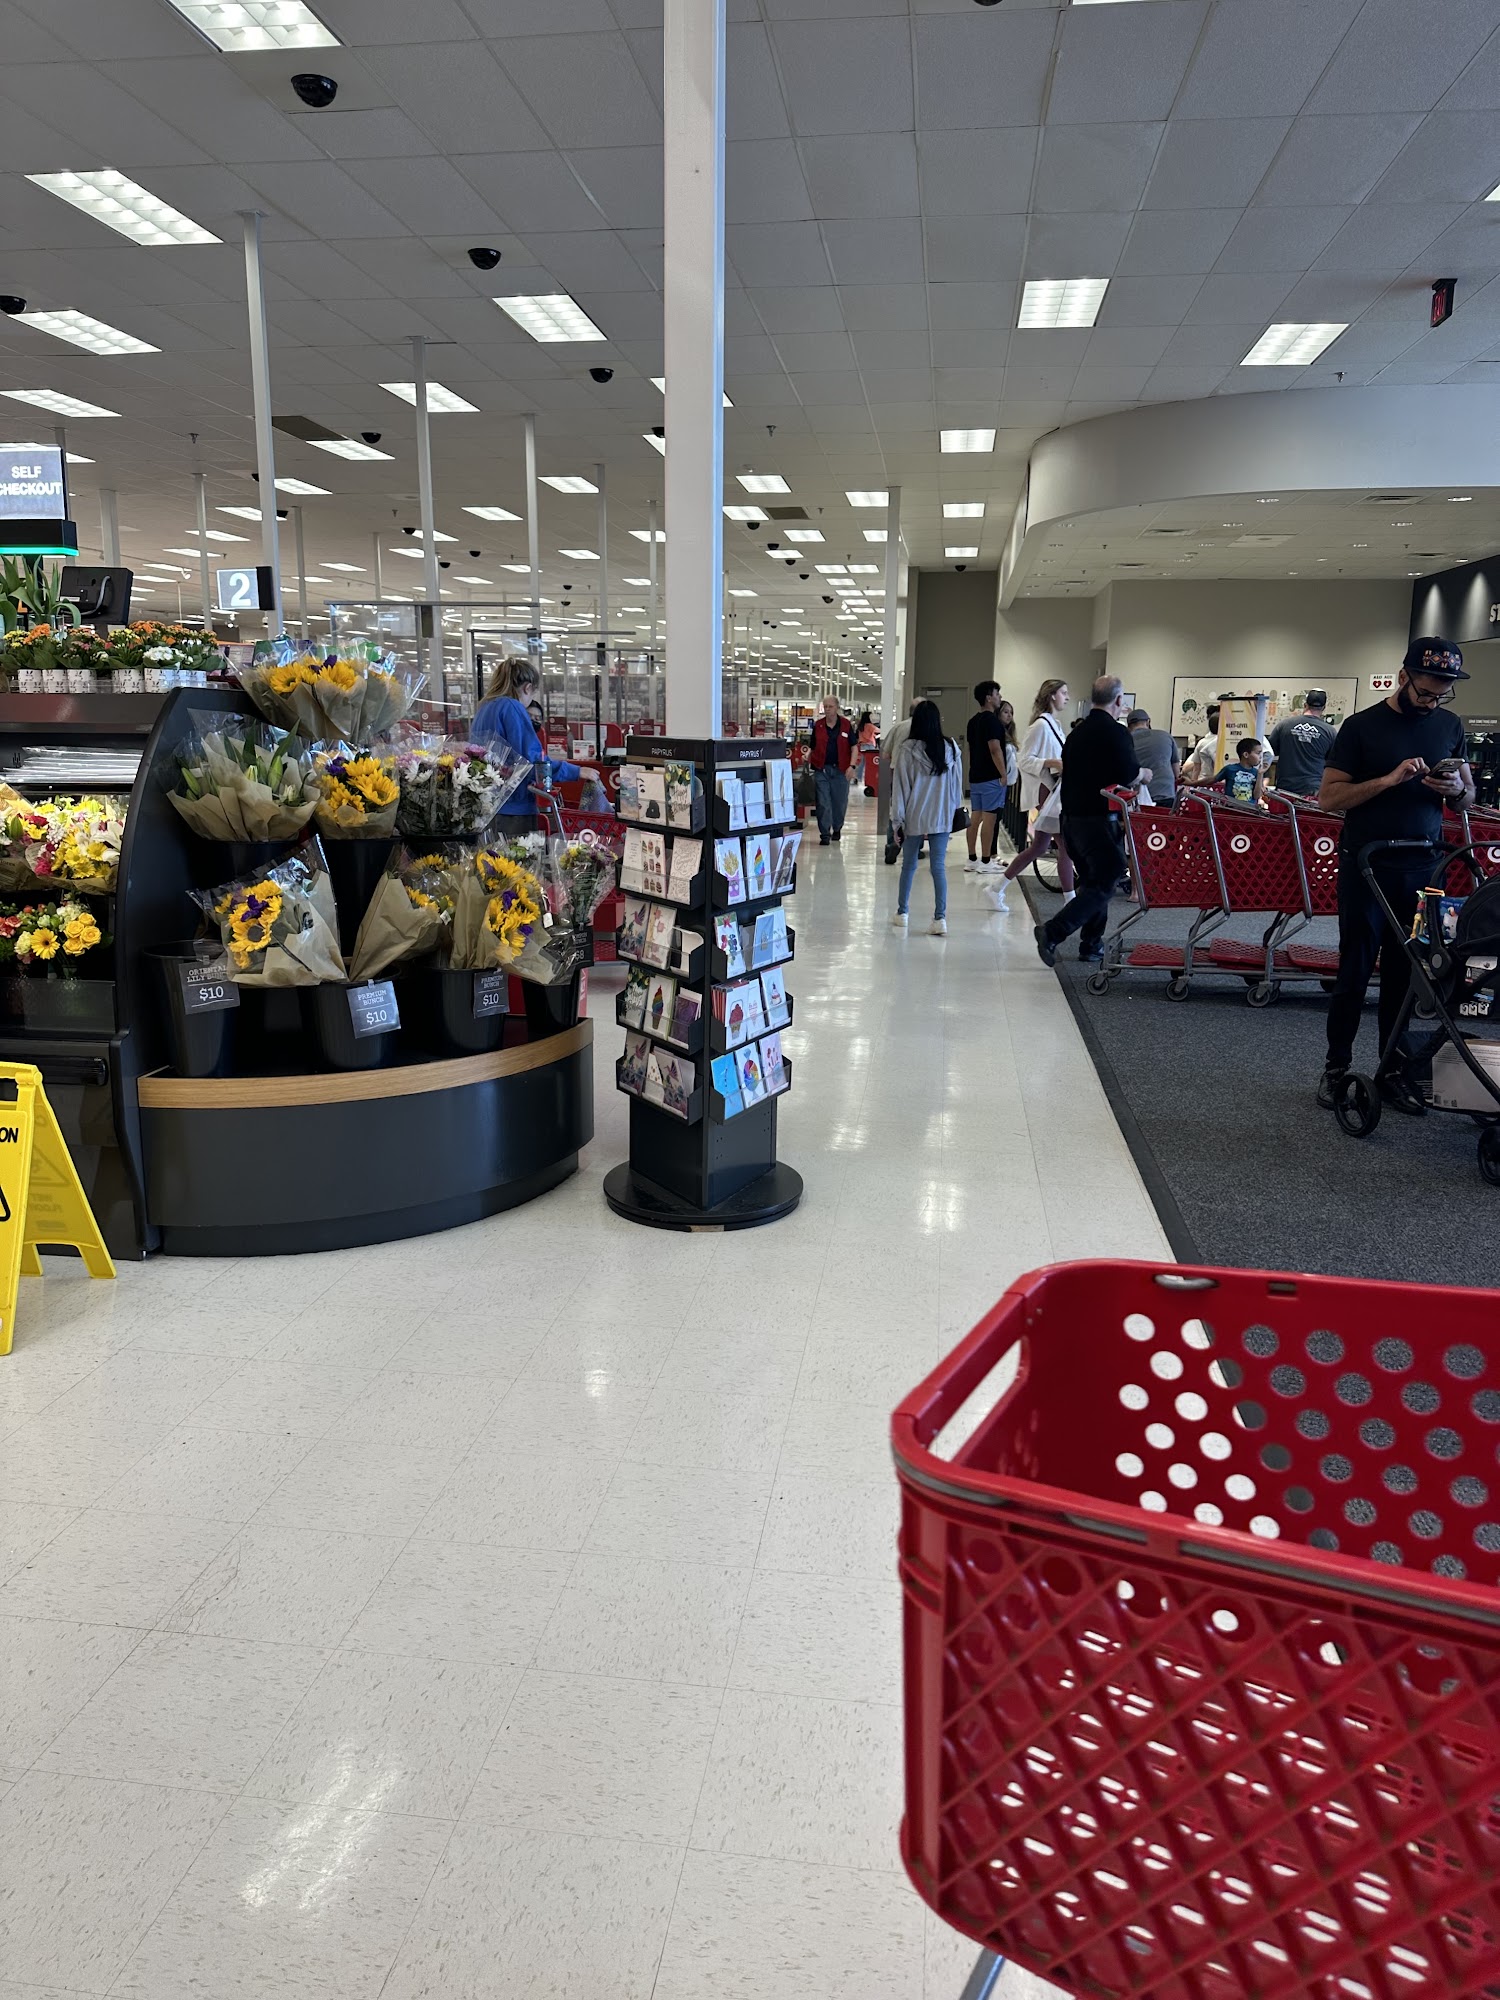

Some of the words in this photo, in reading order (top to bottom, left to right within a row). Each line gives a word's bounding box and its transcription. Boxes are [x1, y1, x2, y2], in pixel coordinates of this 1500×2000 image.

[11, 465, 42, 479] SELF
[229, 572, 251, 607] 2
[651, 747, 673, 757] PAPYRUS
[739, 750, 760, 758] PAPYRUS
[188, 965, 227, 976] ORIENTAL
[199, 986, 224, 1001] $10
[357, 990, 387, 1000] PREMIUM
[482, 993, 499, 1006] $10
[363, 996, 385, 1005] BUNCH
[366, 1010, 387, 1025] $10
[0, 1127, 19, 1143] ON
